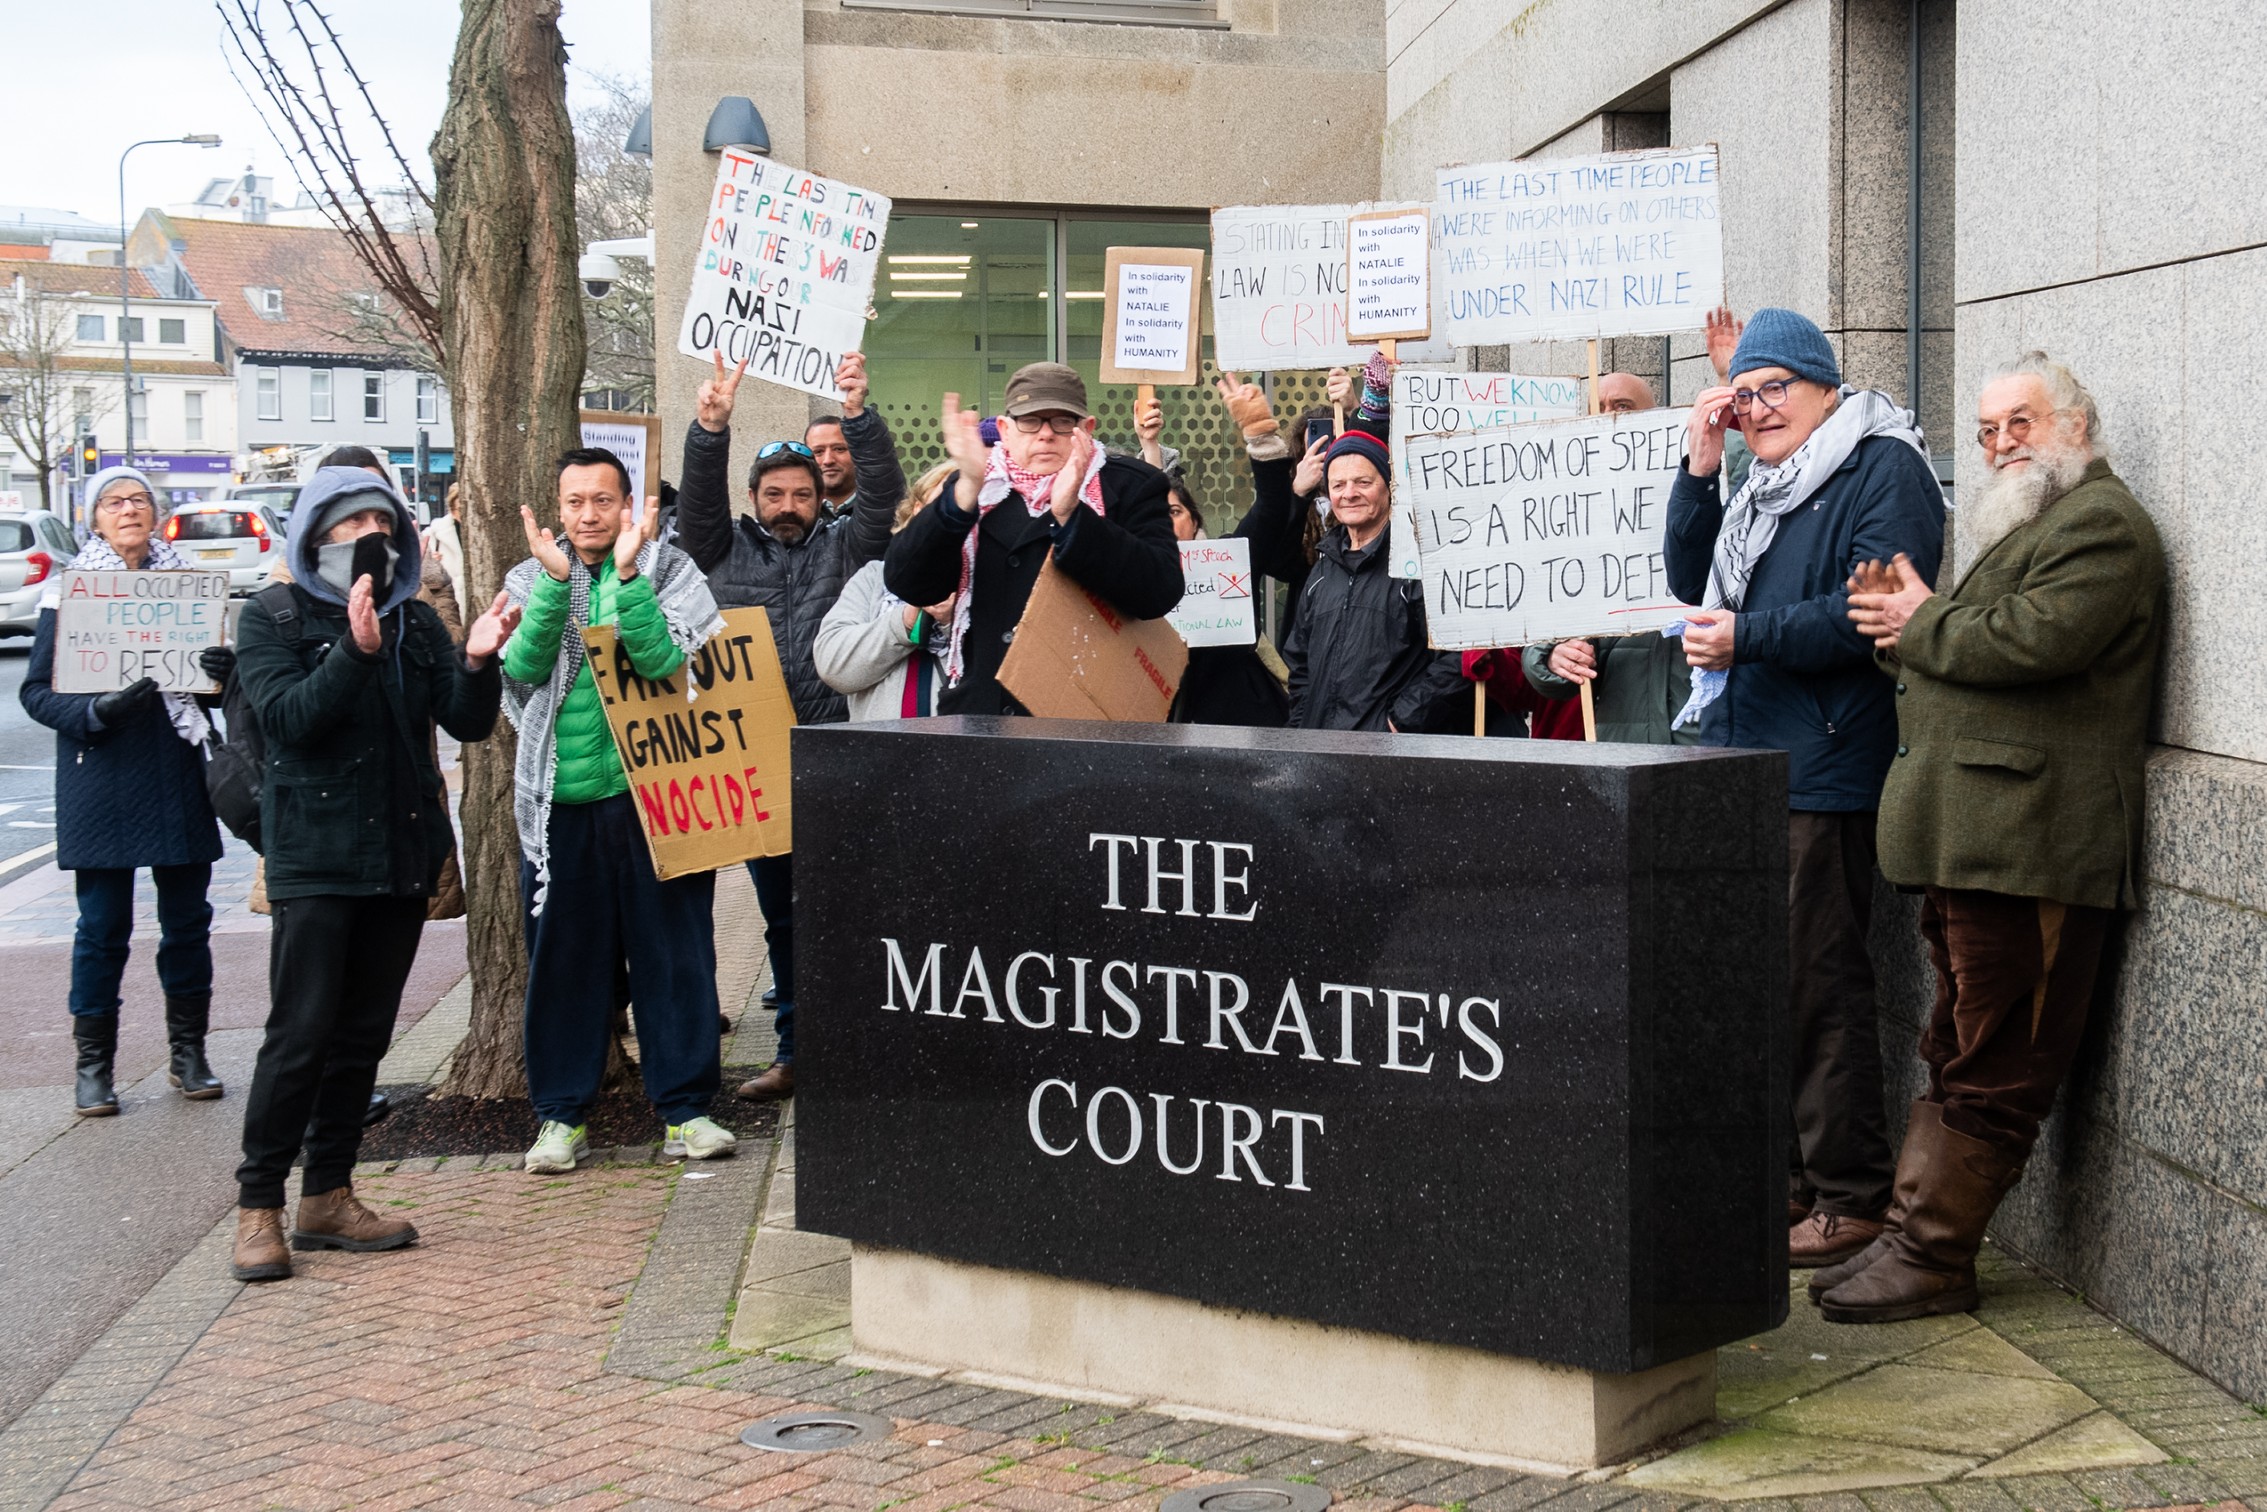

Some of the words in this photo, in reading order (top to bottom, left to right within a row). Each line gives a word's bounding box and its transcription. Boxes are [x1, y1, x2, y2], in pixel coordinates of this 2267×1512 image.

[725, 153, 783, 191] THE
[783, 174, 846, 210] LAST
[1441, 177, 1489, 203] THE
[1500, 172, 1562, 199] LAST
[1570, 165, 1625, 192] TIME
[1630, 159, 1718, 190] PEOPLE
[717, 183, 793, 225] PEOPLE
[795, 205, 877, 253] INFORMED
[1358, 228, 1368, 238] In
[1371, 224, 1421, 237] solidarity
[1442, 211, 1496, 238] WERE
[1505, 201, 1612, 232] INFORMING
[1619, 198, 1639, 224] ON
[1645, 194, 1718, 224] OTHERS
[710, 216, 738, 250] ON
[819, 249, 863, 284] WAS
[1222, 220, 1310, 255] STATING
[1319, 220, 1345, 250] IN
[1358, 243, 1380, 253] with
[1447, 246, 1490, 275] WAS
[1505, 238, 1568, 270] WHEN
[1577, 234, 1608, 266] WE
[1615, 230, 1677, 262] WERE
[704, 250, 774, 294] DURING
[777, 277, 812, 305] OUR
[1128, 272, 1138, 280] In
[1140, 272, 1186, 283] solidarity
[1358, 257, 1405, 270] NATALIE
[1358, 278, 1368, 287] In
[1371, 274, 1421, 287] solidarity
[1127, 287, 1148, 295] with
[1219, 266, 1267, 299] LAW
[1283, 264, 1307, 296] IS
[1449, 283, 1531, 320] UNDER
[1550, 277, 1608, 311] NAZI
[1623, 271, 1692, 308] RULE
[725, 287, 801, 335] NAZI
[1126, 302, 1170, 312] NATALIE
[1358, 294, 1380, 305] with
[1358, 307, 1418, 320] HUMANITY
[1124, 334, 1146, 343] with
[1125, 318, 1135, 326] In
[1138, 318, 1183, 330] solidarity
[691, 312, 844, 393] OCCUPATION
[1124, 348, 1179, 358] HUMANITY
[1464, 377, 1508, 405] WE
[1510, 378, 1576, 403] KNOW
[1405, 405, 1460, 432] TOO
[584, 431, 636, 445] Standing
[1420, 438, 1558, 490] FREEDOM
[1566, 436, 1600, 477] OF
[1431, 507, 1472, 546] IS
[1486, 503, 1509, 547] A
[1522, 491, 1602, 541] RIGHT
[1612, 486, 1655, 535] WE
[69, 576, 129, 598] ALL
[134, 574, 225, 598] OCCUPIED
[1441, 562, 1525, 615] NEED
[1542, 556, 1585, 603] TO
[1599, 552, 1673, 602] DEF
[107, 602, 207, 626] PEOPLE
[1217, 617, 1243, 629] LAW
[67, 631, 117, 647] HAVE
[126, 630, 162, 643] THE
[168, 631, 210, 643] RIGHT
[76, 650, 109, 673] TO
[119, 649, 211, 688] RESIS
[1134, 647, 1173, 700] FRAGILE
[1088, 832, 1258, 922] THE
[880, 937, 1505, 1084] MAGISTRATE'S
[1027, 1077, 1325, 1192] COURT
